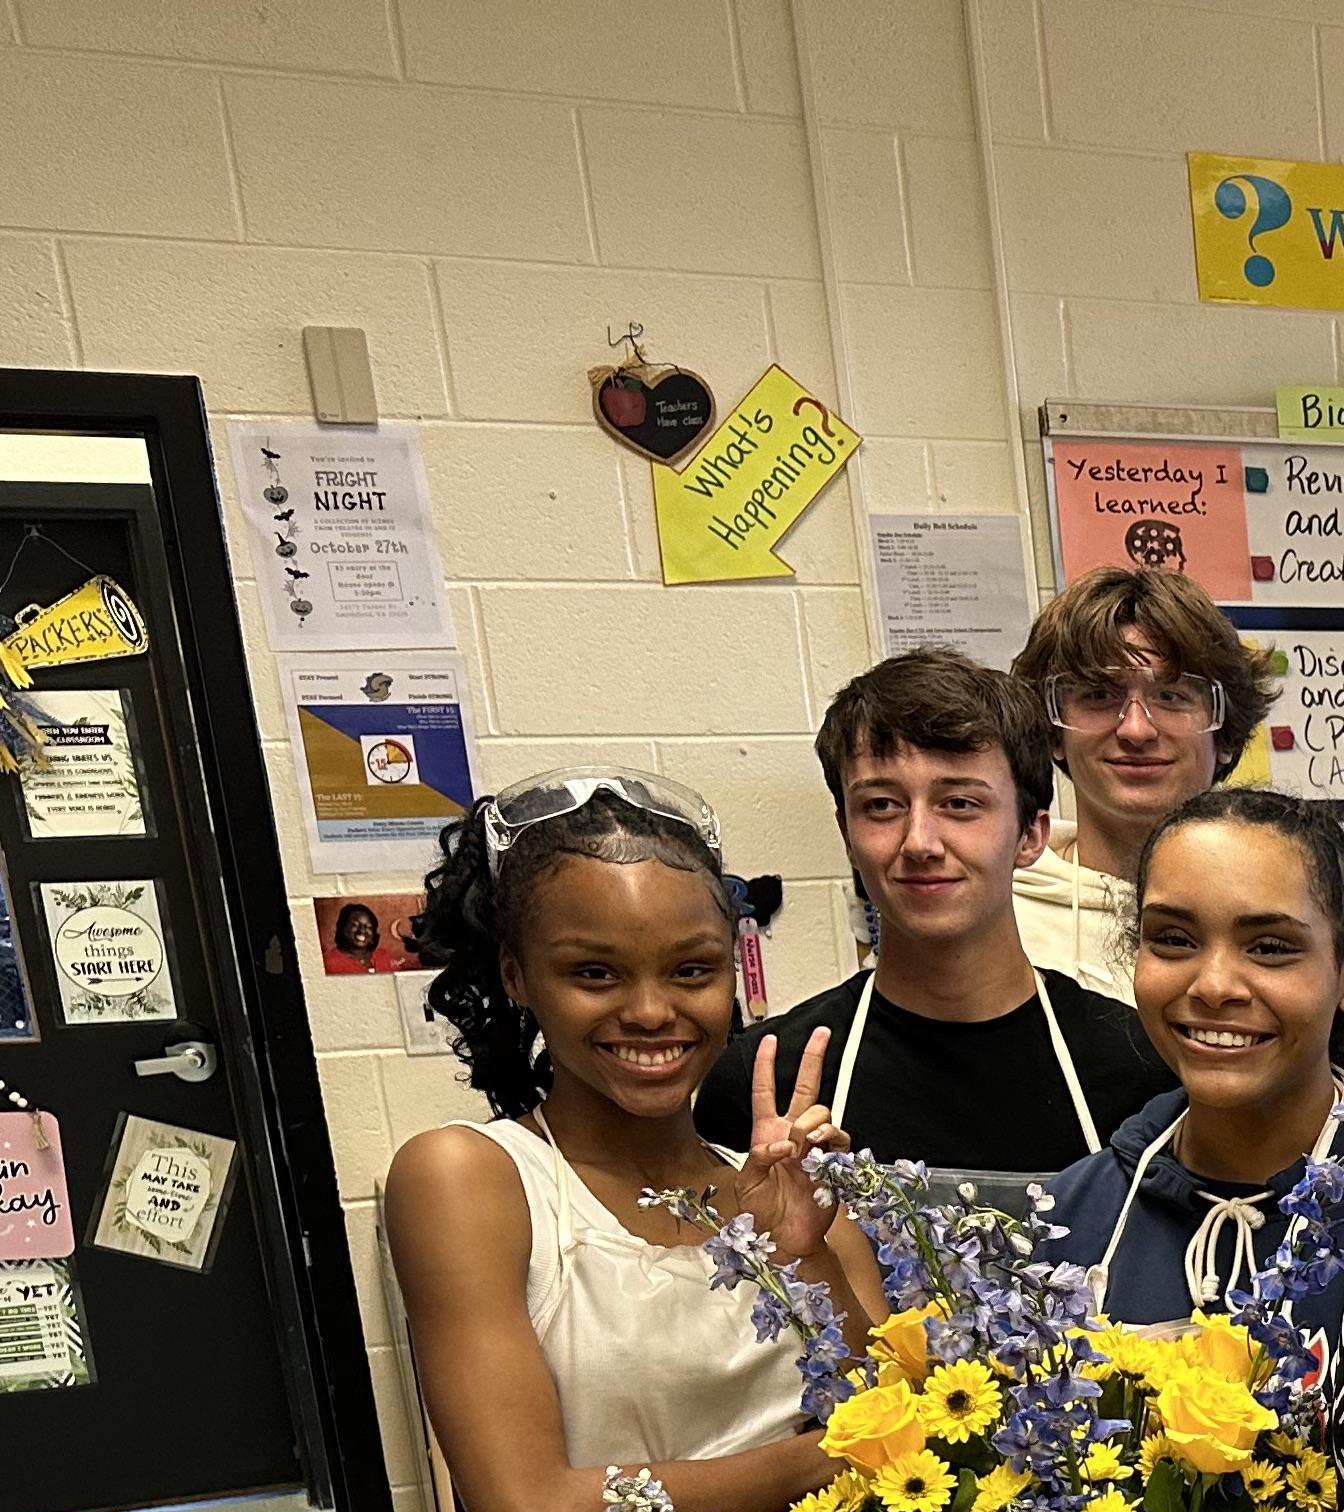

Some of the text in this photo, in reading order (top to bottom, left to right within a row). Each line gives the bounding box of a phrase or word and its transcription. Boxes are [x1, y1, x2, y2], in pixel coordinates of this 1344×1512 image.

[656, 400, 698, 413] Teachers
[684, 408, 773, 498] What's
[315, 471, 377, 487] FRIGHT
[1067, 457, 1229, 495] Yesterday I
[314, 491, 386, 511] NIGHT
[1285, 508, 1341, 537] and
[310, 540, 409, 554] October 27th
[9, 607, 114, 662] PACKERS
[63, 921, 143, 942] Awesome
[84, 944, 135, 960] things
[71, 959, 156, 976] START HERE
[152, 1153, 198, 1180] This
[141, 1172, 201, 1193] MAY TAKE
[147, 1195, 181, 1212] AND
[137, 1208, 184, 1229] effort
[16, 1283, 56, 1301] YET
